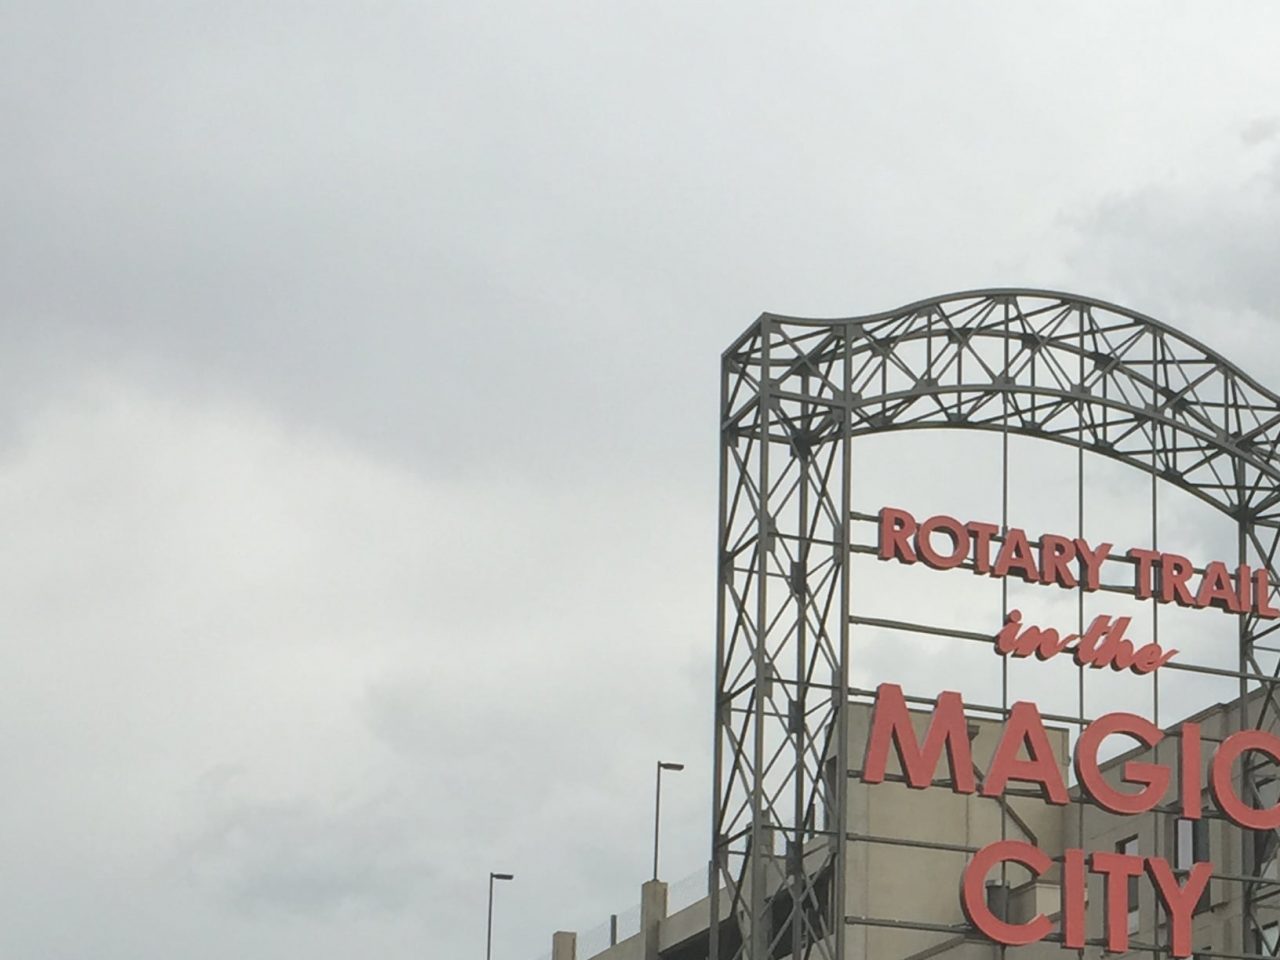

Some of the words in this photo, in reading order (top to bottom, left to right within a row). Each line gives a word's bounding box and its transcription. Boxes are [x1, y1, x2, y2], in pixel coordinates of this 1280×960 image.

[879, 507, 1112, 592] ROTARY
[1127, 548, 1280, 619] TRAIL
[995, 610, 1078, 660] in
[1073, 614, 1180, 675] the
[960, 839, 1214, 958] CITY
